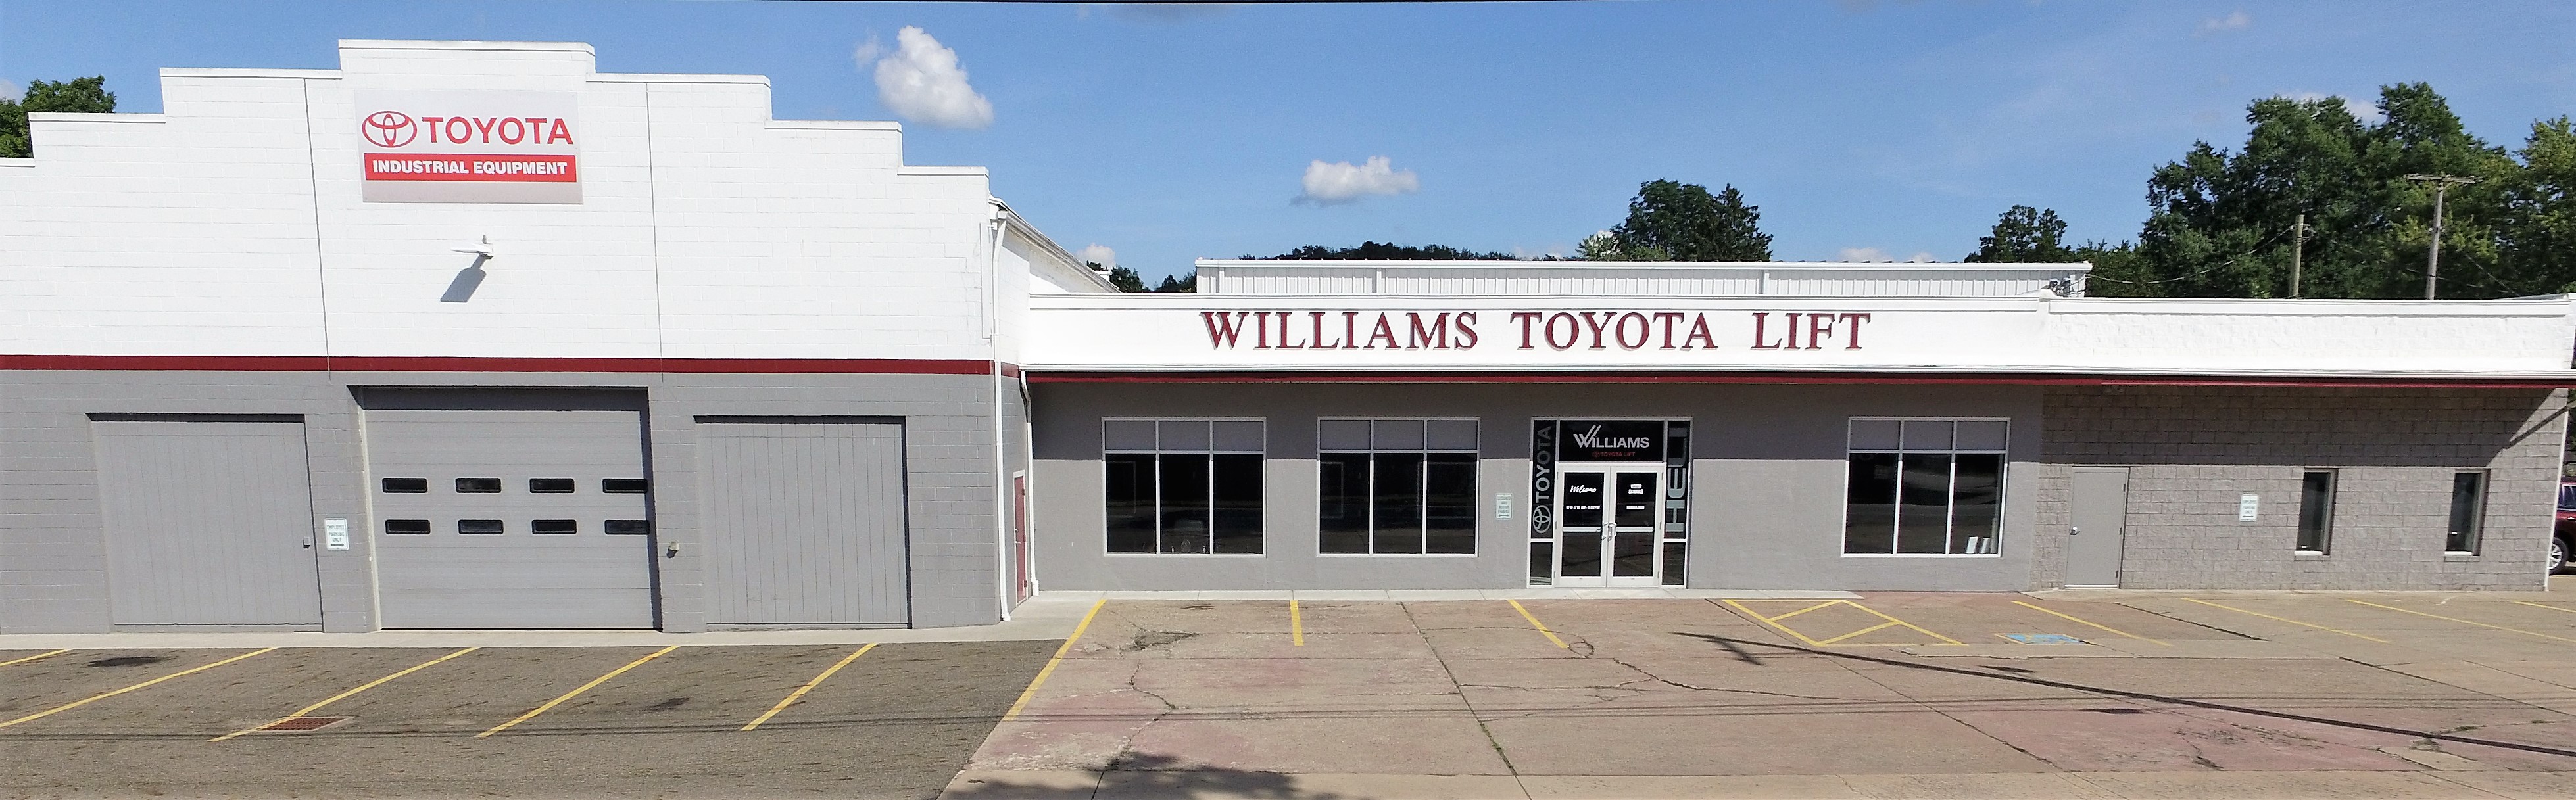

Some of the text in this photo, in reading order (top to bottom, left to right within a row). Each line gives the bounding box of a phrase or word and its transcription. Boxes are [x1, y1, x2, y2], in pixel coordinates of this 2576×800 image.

[422, 116, 574, 145] TOYOTA
[372, 160, 568, 176] INDUSTRIAL EQUIPMENT
[1199, 312, 1872, 351] WILLIAMS TOYOTA LIFT
[1572, 425, 1650, 448] WILLIAMS
[1535, 426, 1551, 504] TOYOTA
